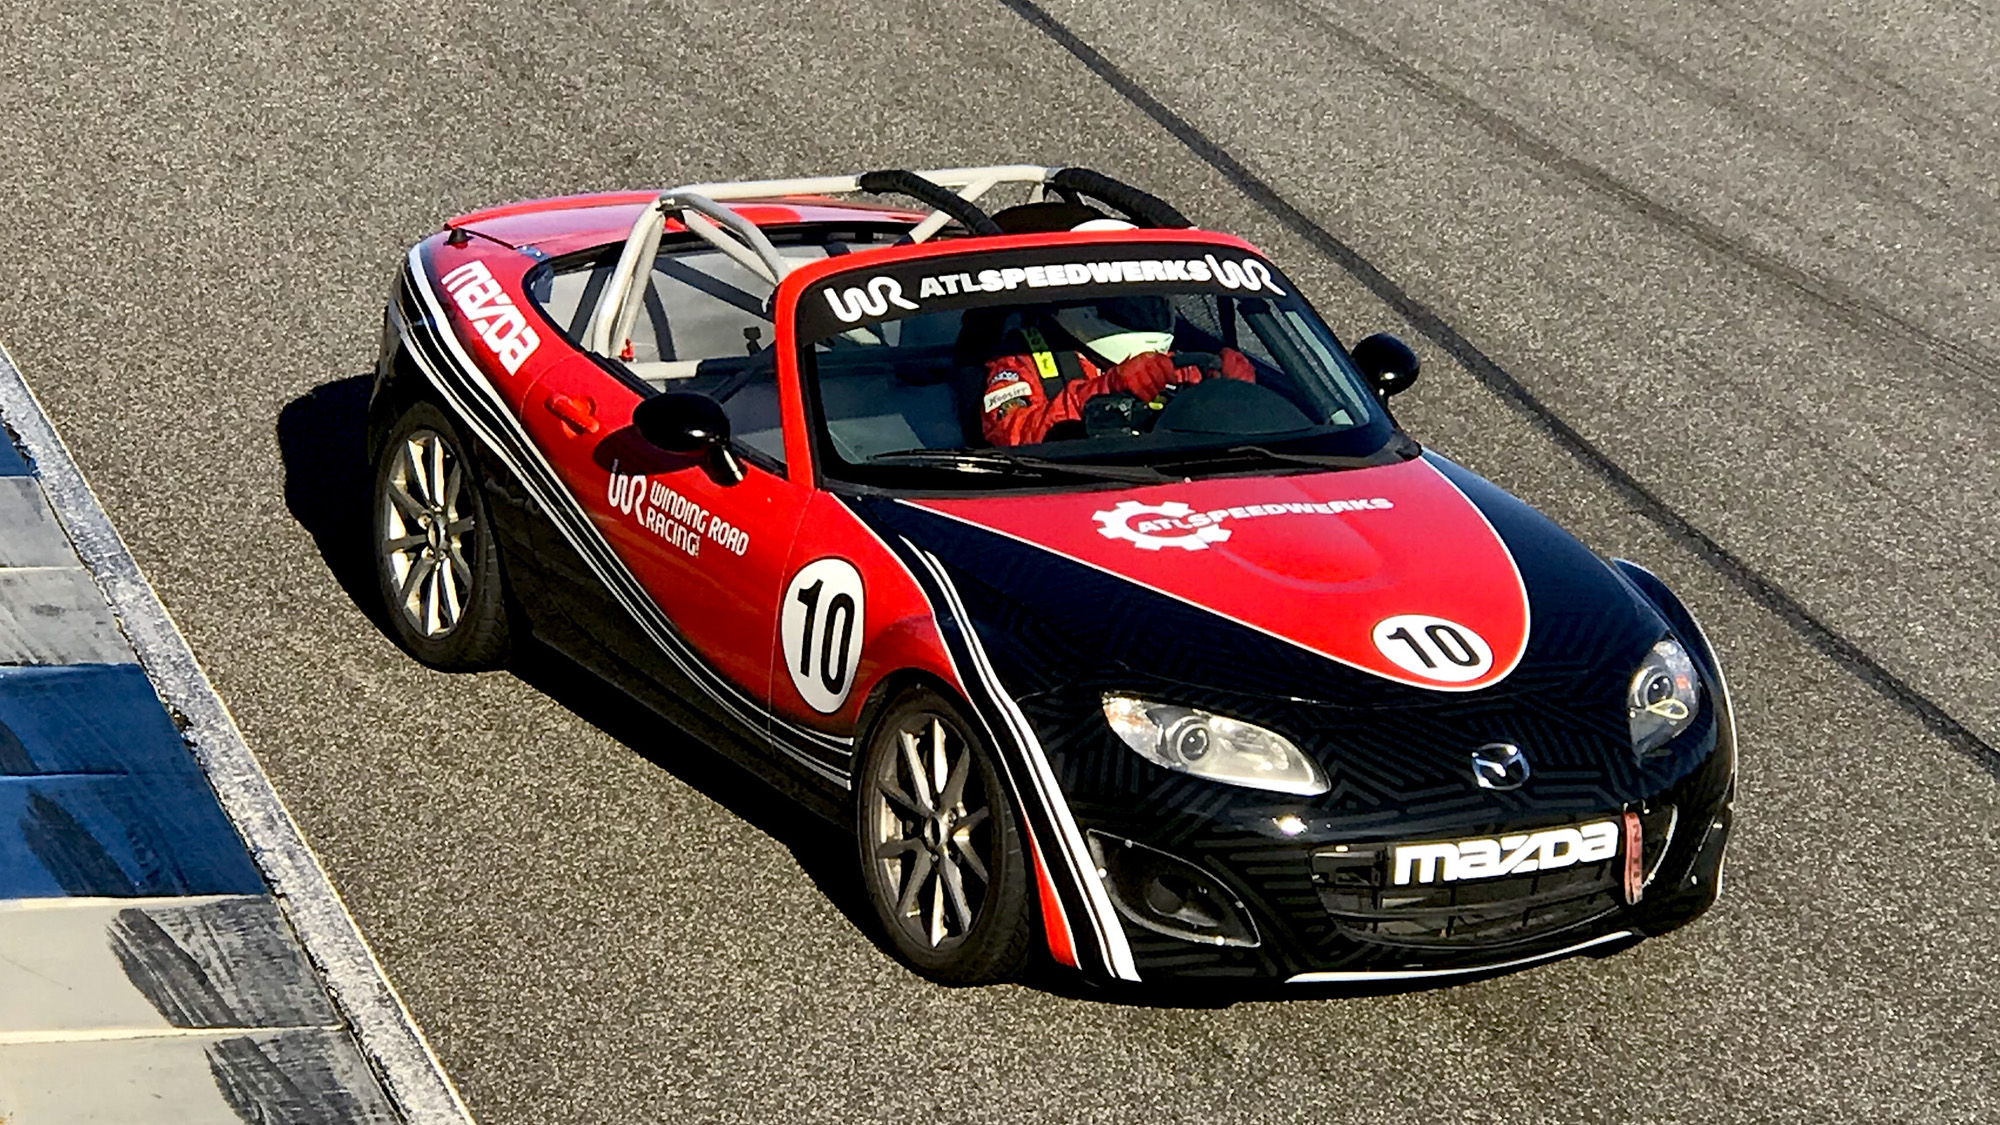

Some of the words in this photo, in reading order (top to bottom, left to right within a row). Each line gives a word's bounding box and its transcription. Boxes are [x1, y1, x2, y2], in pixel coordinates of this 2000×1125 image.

[919, 259, 1212, 299] ATLSPEEDWERKS
[645, 506, 699, 557] RACING
[650, 480, 710, 534] WINDING
[707, 515, 750, 557] ROAD
[1137, 497, 1395, 535] ATLSPEEDWERKS
[797, 578, 856, 696] 10
[1386, 624, 1481, 669] 10
